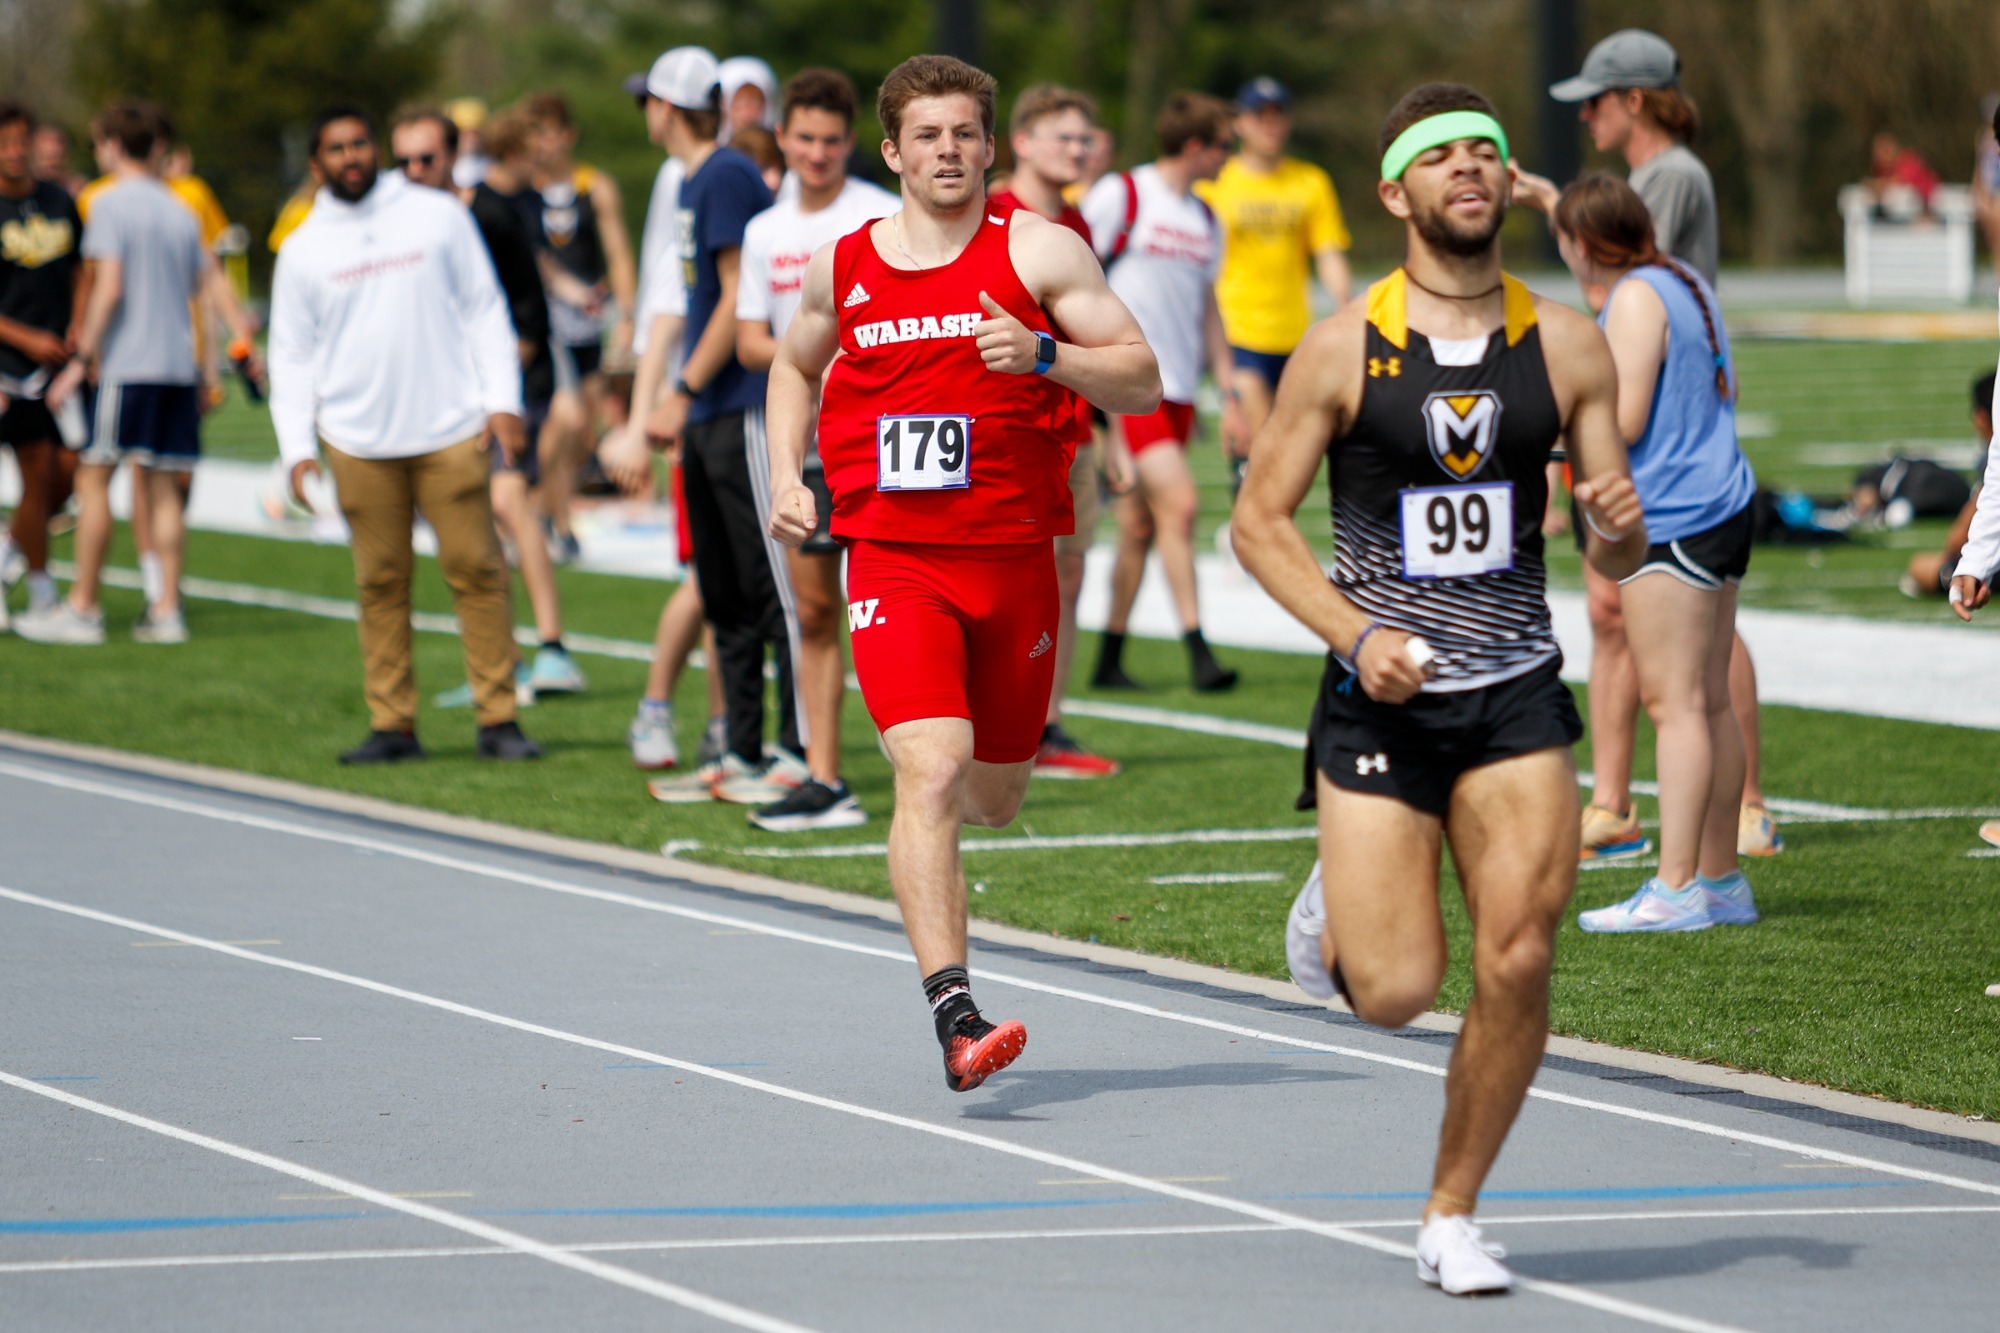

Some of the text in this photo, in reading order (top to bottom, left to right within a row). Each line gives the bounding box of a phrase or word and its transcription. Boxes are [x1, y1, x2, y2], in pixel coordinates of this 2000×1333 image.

[843, 294, 871, 308] adidas
[853, 312, 982, 348] WABASH
[883, 419, 965, 473] 179
[1429, 397, 1496, 456] M
[1427, 493, 1490, 556] 99
